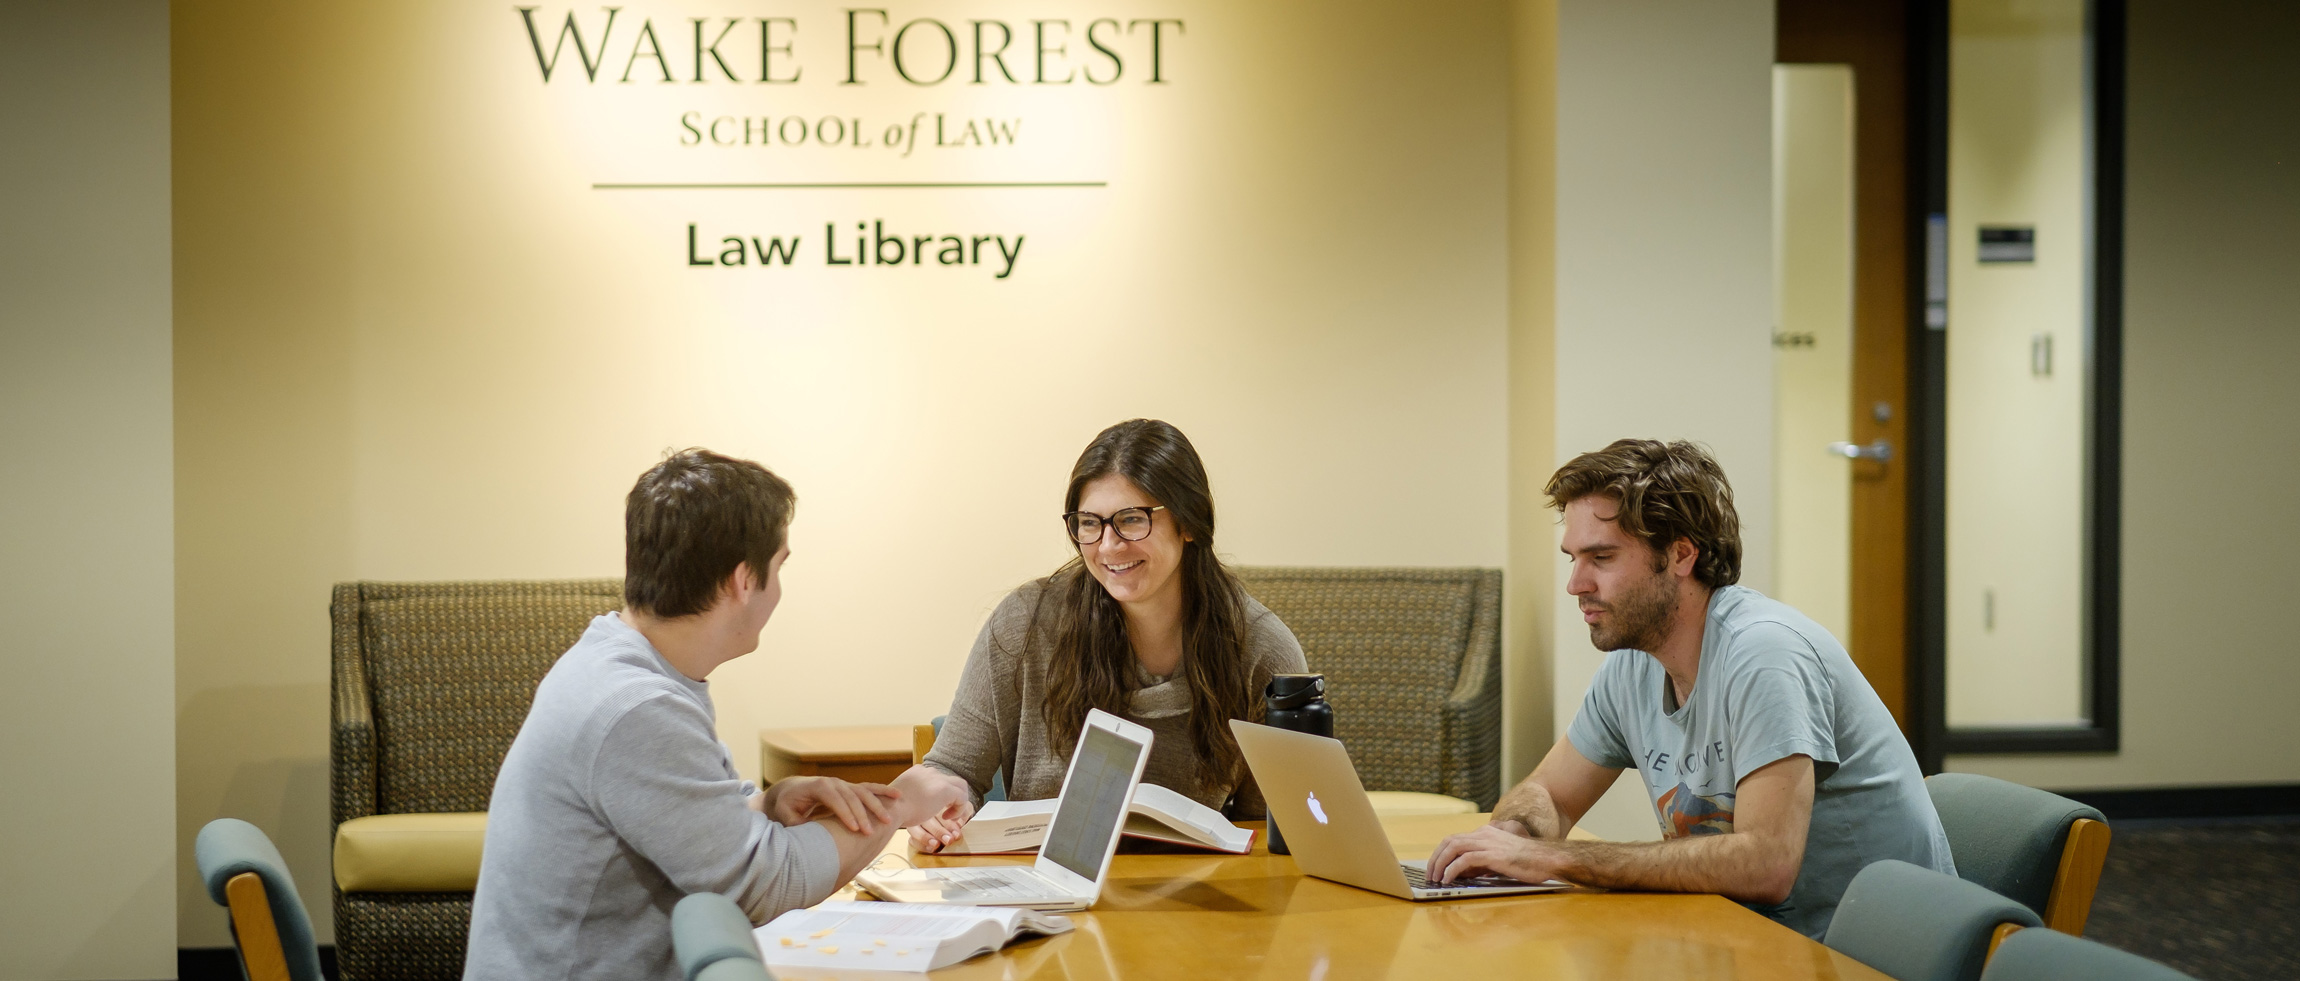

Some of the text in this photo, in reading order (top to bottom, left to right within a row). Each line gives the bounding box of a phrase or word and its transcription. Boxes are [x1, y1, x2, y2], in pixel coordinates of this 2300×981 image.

[515, 6, 1186, 86] WAKE FOREST
[680, 112, 1021, 156] SCHOOL of LAW
[687, 219, 1025, 280] Law Library
